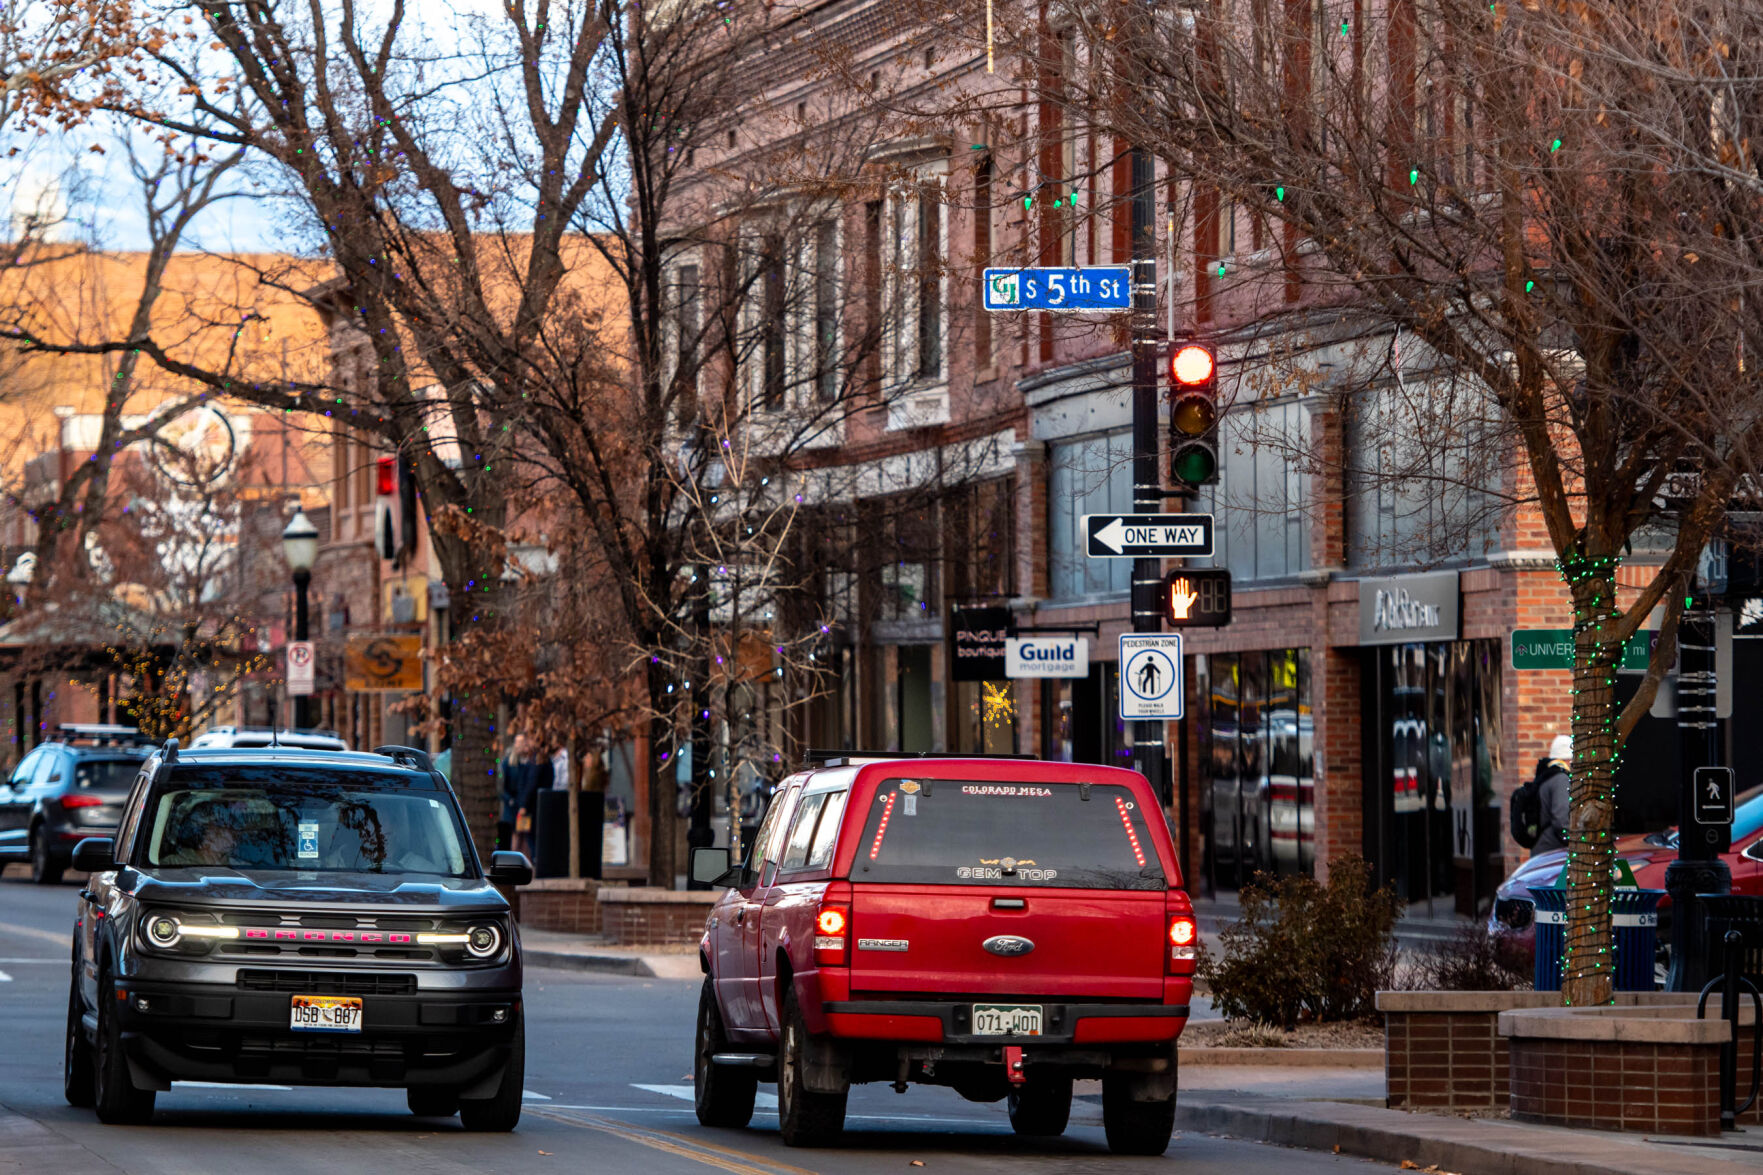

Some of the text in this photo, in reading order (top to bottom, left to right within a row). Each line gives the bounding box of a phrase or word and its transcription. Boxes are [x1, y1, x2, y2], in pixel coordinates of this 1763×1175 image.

[1025, 274, 1120, 304] S 5th St
[1125, 528, 1199, 543] ONE WAY
[956, 630, 1006, 642] PINQUE
[1122, 639, 1177, 648] PEDESTRIAN ZONE
[1529, 642, 1576, 656] UNIVER
[1632, 642, 1646, 656] mi
[1020, 643, 1075, 661] Guild
[1020, 662, 1075, 672] mortgage
[962, 785, 1052, 797] COLORADO MESA
[956, 866, 1057, 880] GEM TOP
[246, 929, 411, 943] BRONCO
[859, 939, 908, 948] RANGER
[994, 938, 1024, 952] Ford
[294, 1006, 318, 1023] DSB
